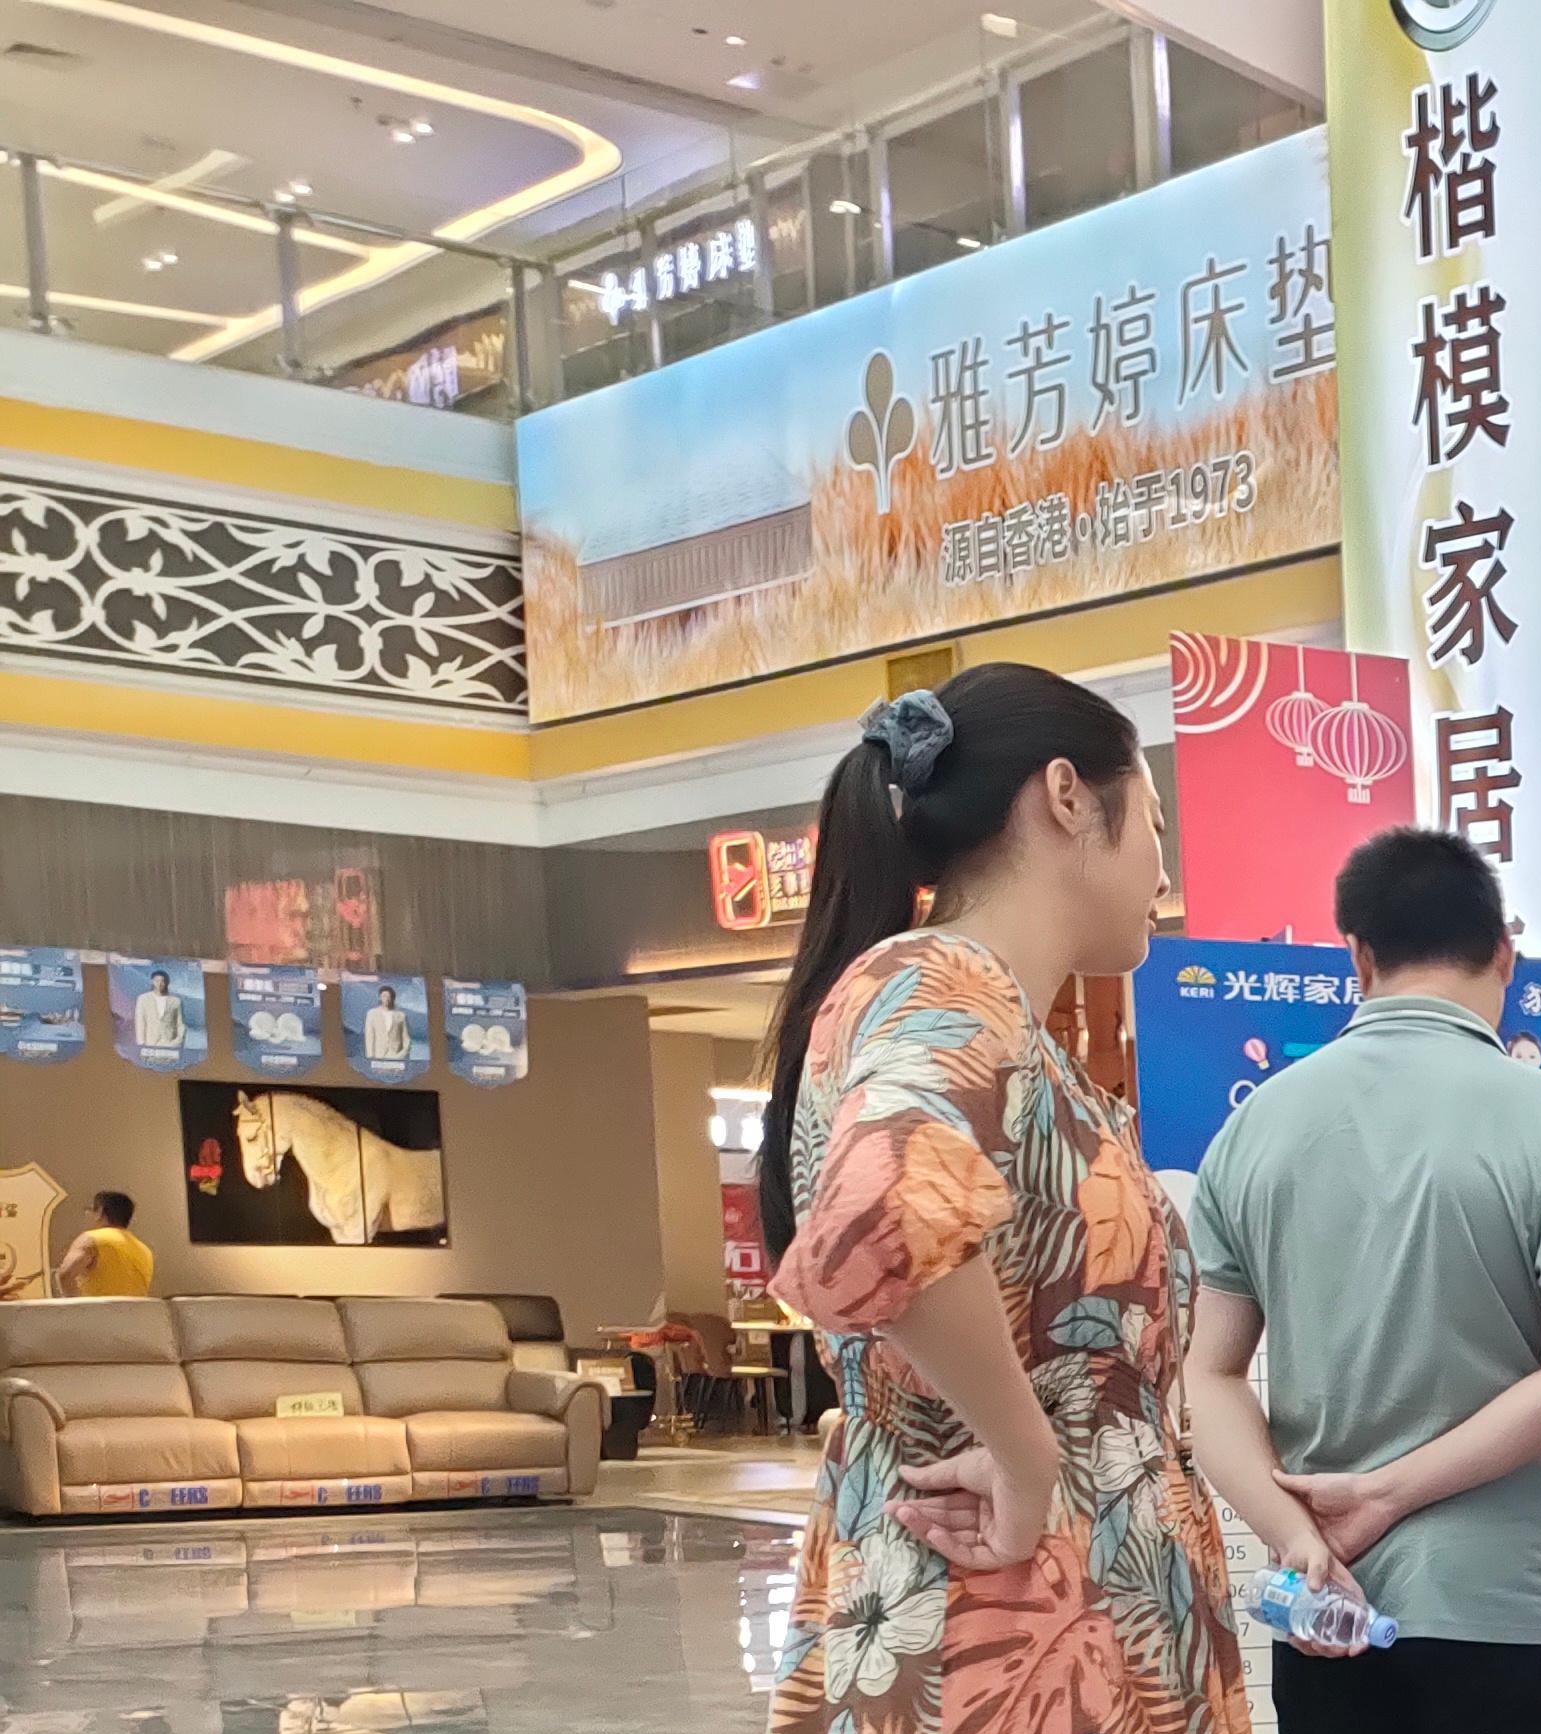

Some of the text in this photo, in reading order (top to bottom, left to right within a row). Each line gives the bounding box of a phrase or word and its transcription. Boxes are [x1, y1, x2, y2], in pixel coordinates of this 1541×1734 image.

[930, 224, 1335, 480] 雅芳婷床垫
[1403, 72, 1525, 958] 楷模家居
[1180, 985, 1215, 999] KERI
[1225, 1545, 1247, 1561] 05
